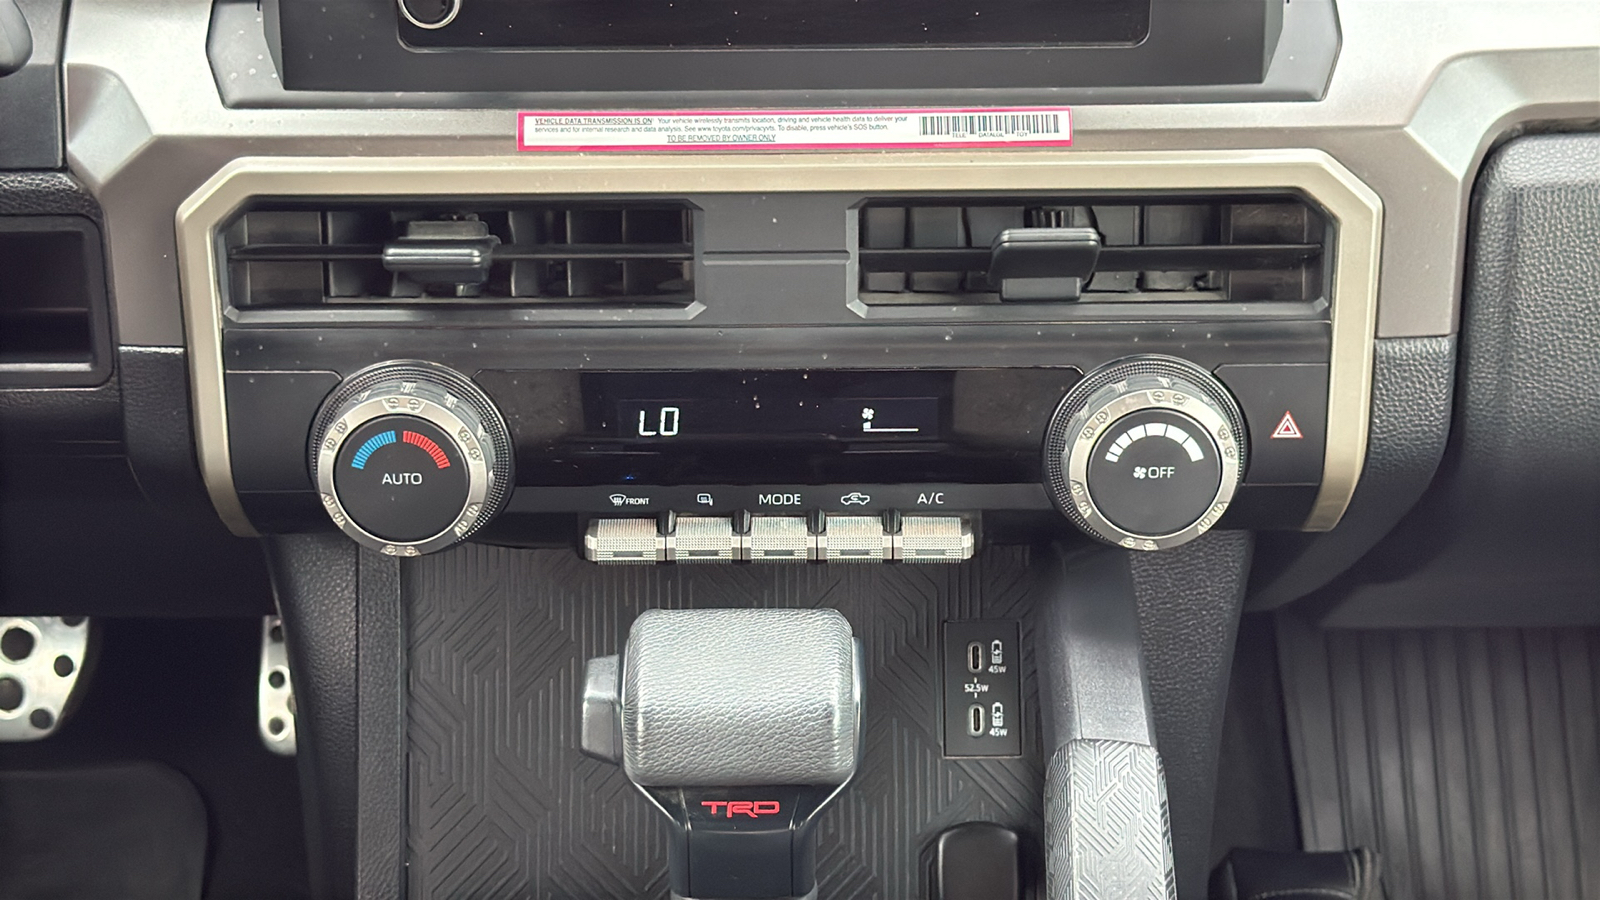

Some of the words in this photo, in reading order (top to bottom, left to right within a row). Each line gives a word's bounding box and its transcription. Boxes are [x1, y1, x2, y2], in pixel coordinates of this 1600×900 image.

[694, 117, 722, 125] wirelessly
[777, 116, 797, 124] driving
[657, 125, 683, 133] analysis.
[732, 134, 757, 142] OWNER
[758, 134, 776, 142] ONLY
[638, 406, 680, 436] LO
[1147, 466, 1176, 479] OFF
[381, 472, 423, 485] AUTO
[625, 497, 650, 505] FRONT
[758, 493, 803, 505] MODE
[916, 492, 944, 505] A/C
[988, 665, 1007, 673] 45W
[964, 683, 989, 693] 52.5W
[989, 728, 1008, 737] 45W
[701, 801, 780, 818] TRD
